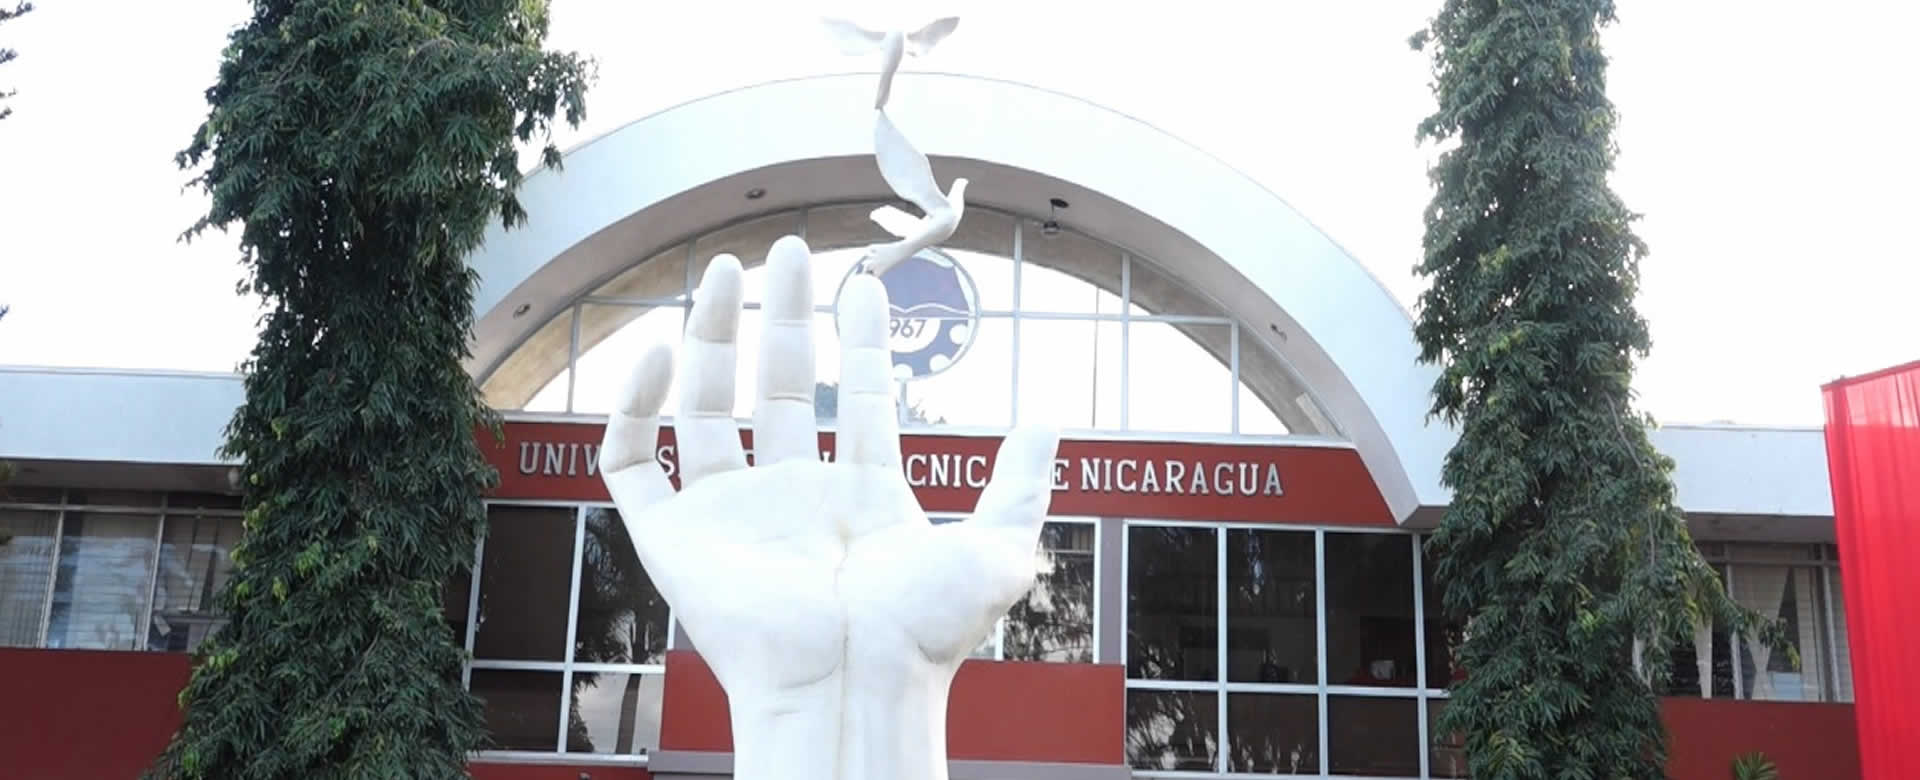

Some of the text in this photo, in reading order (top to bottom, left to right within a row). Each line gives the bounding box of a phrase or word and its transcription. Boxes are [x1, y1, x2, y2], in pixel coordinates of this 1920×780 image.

[889, 319, 928, 339] 967
[1050, 458, 1070, 490] E
[1080, 457, 1284, 495] NICARAGUA
